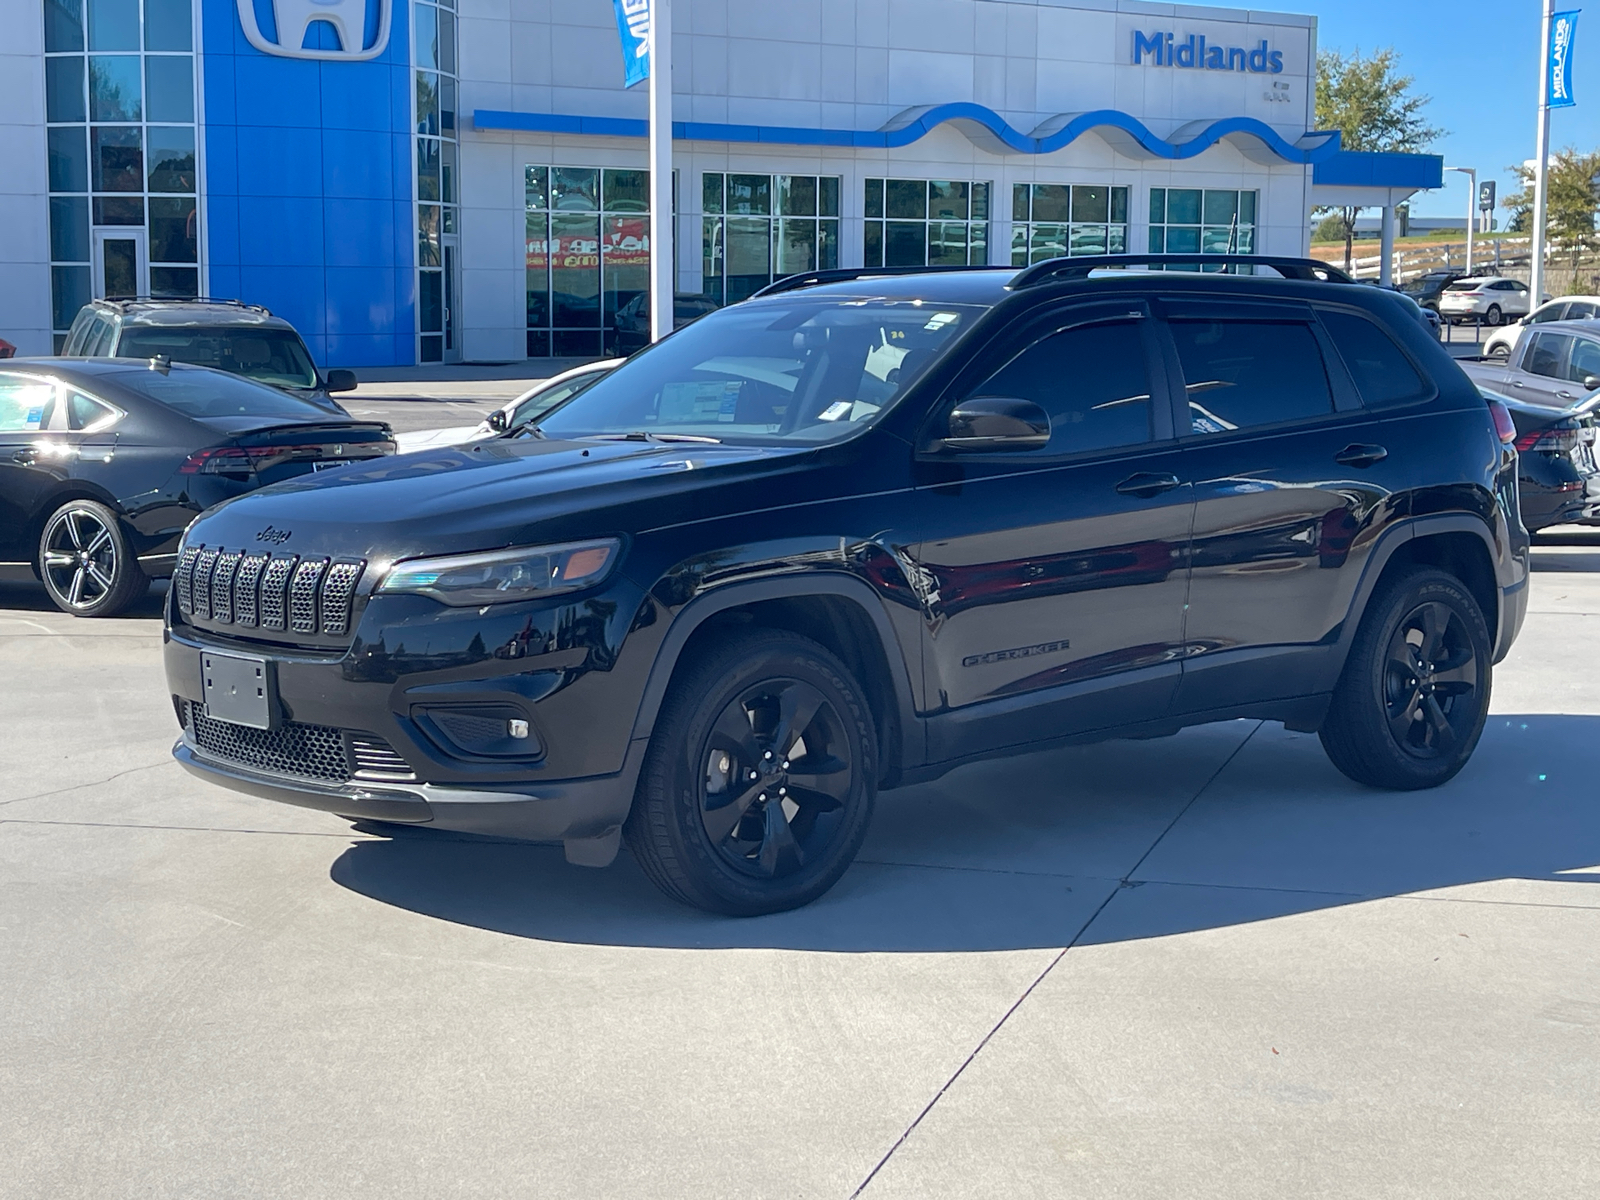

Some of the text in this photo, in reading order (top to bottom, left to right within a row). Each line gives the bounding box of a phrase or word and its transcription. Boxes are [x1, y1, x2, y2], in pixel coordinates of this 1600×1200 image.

[1132, 30, 1284, 74] Midlands
[1553, 18, 1567, 99] MIDLANDS
[1418, 584, 1485, 641] ASSURANCE
[963, 639, 1070, 667] CHEROKEE
[794, 656, 872, 772] ASSURANCE
